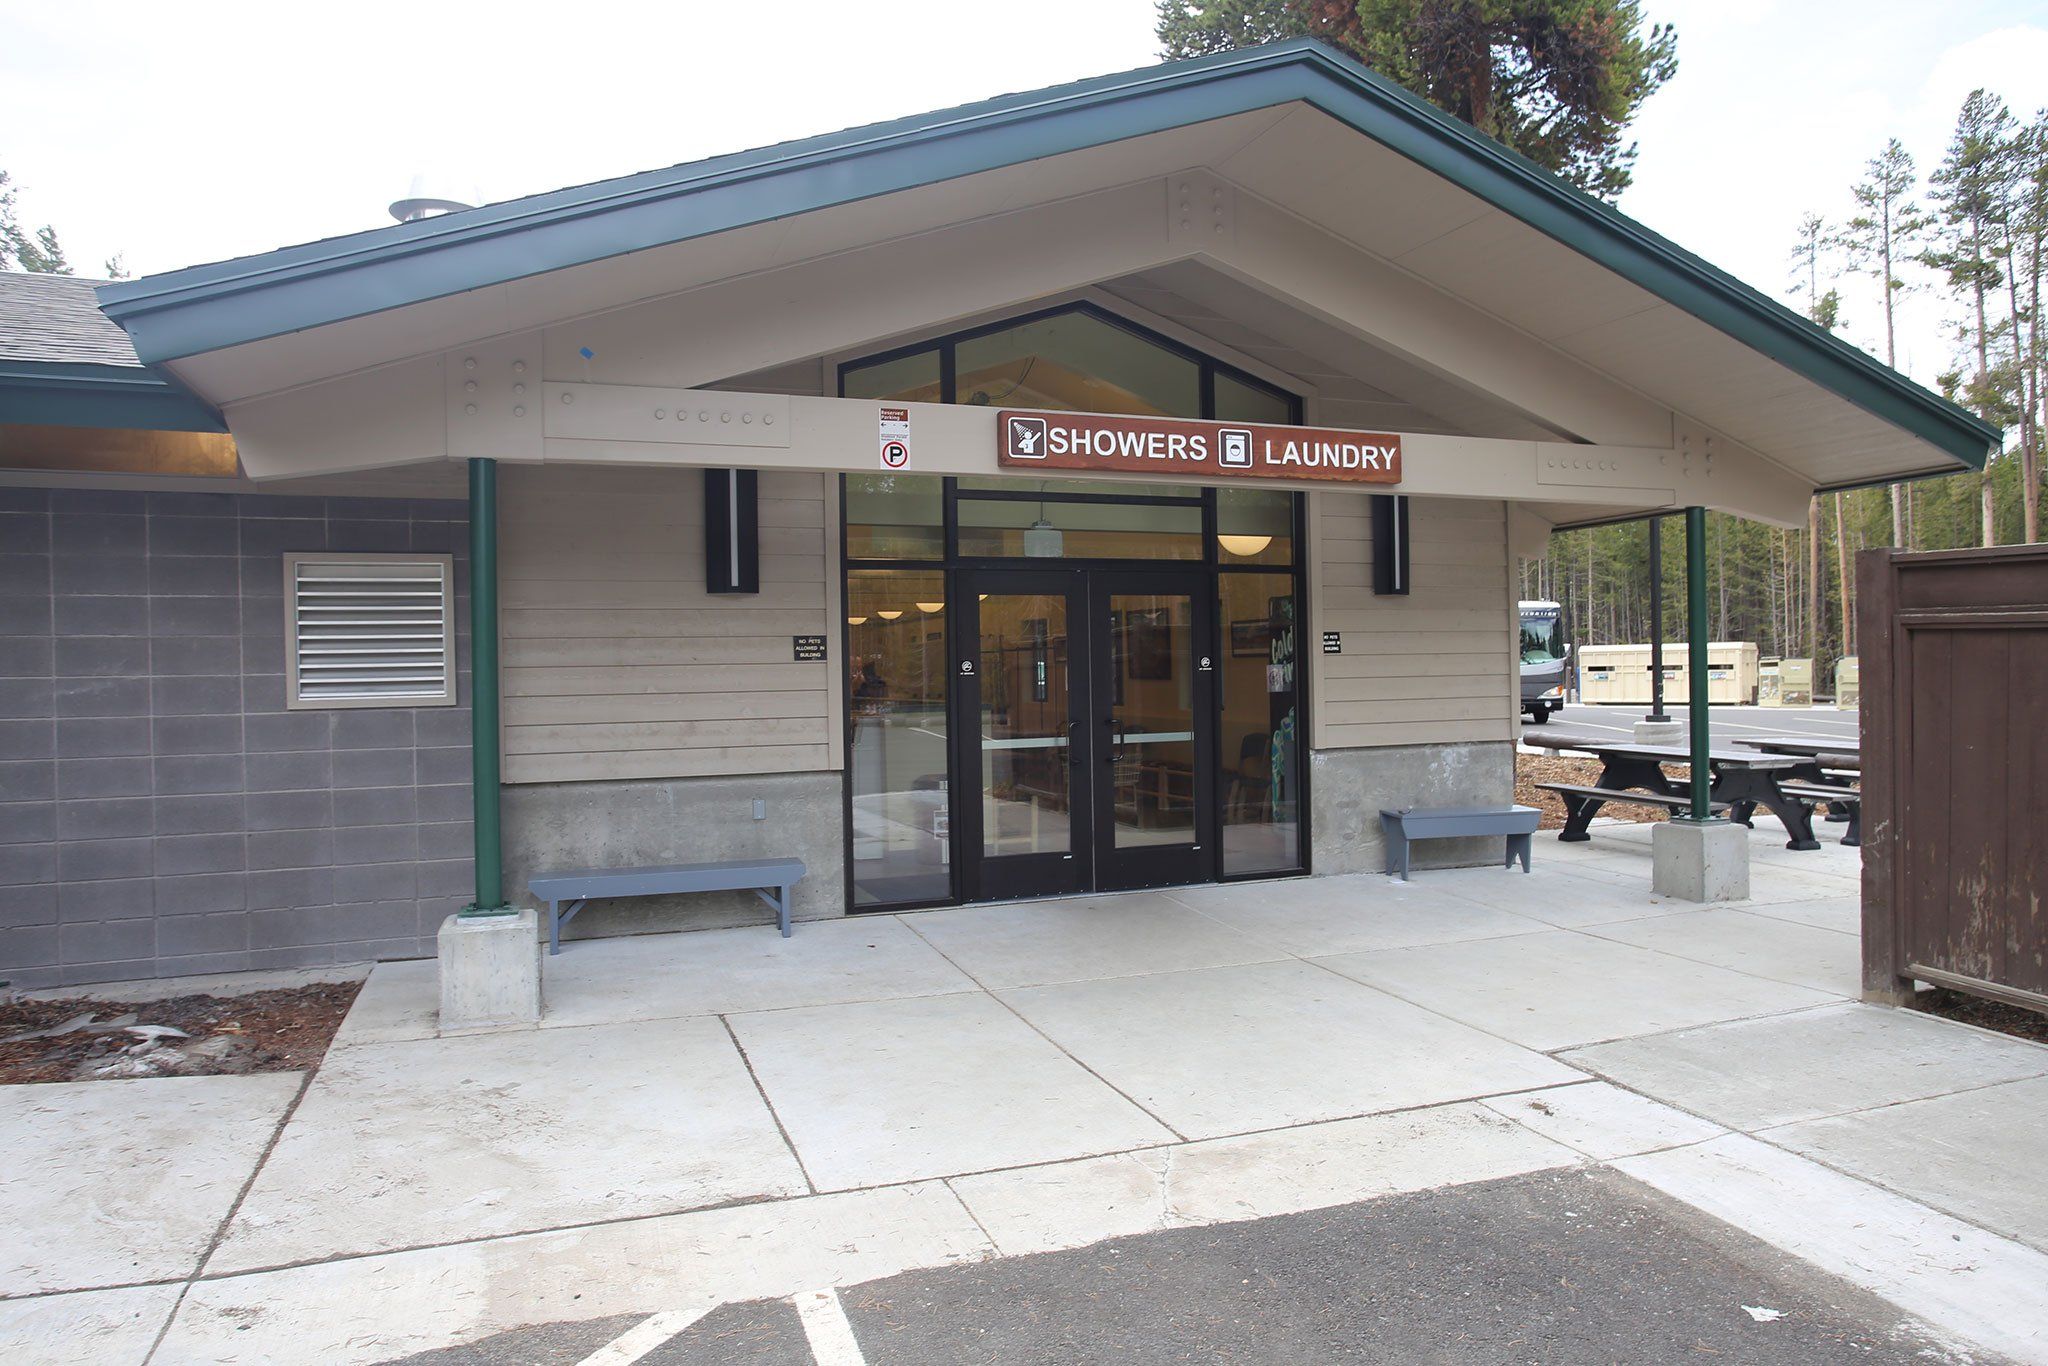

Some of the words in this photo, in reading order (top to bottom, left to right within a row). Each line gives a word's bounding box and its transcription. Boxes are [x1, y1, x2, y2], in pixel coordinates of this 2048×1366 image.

[890, 446, 903, 462] P
[1049, 426, 1208, 461] SHOWERS
[1265, 440, 1397, 470] LAUNDRY
[1272, 625, 1293, 664] Cold
